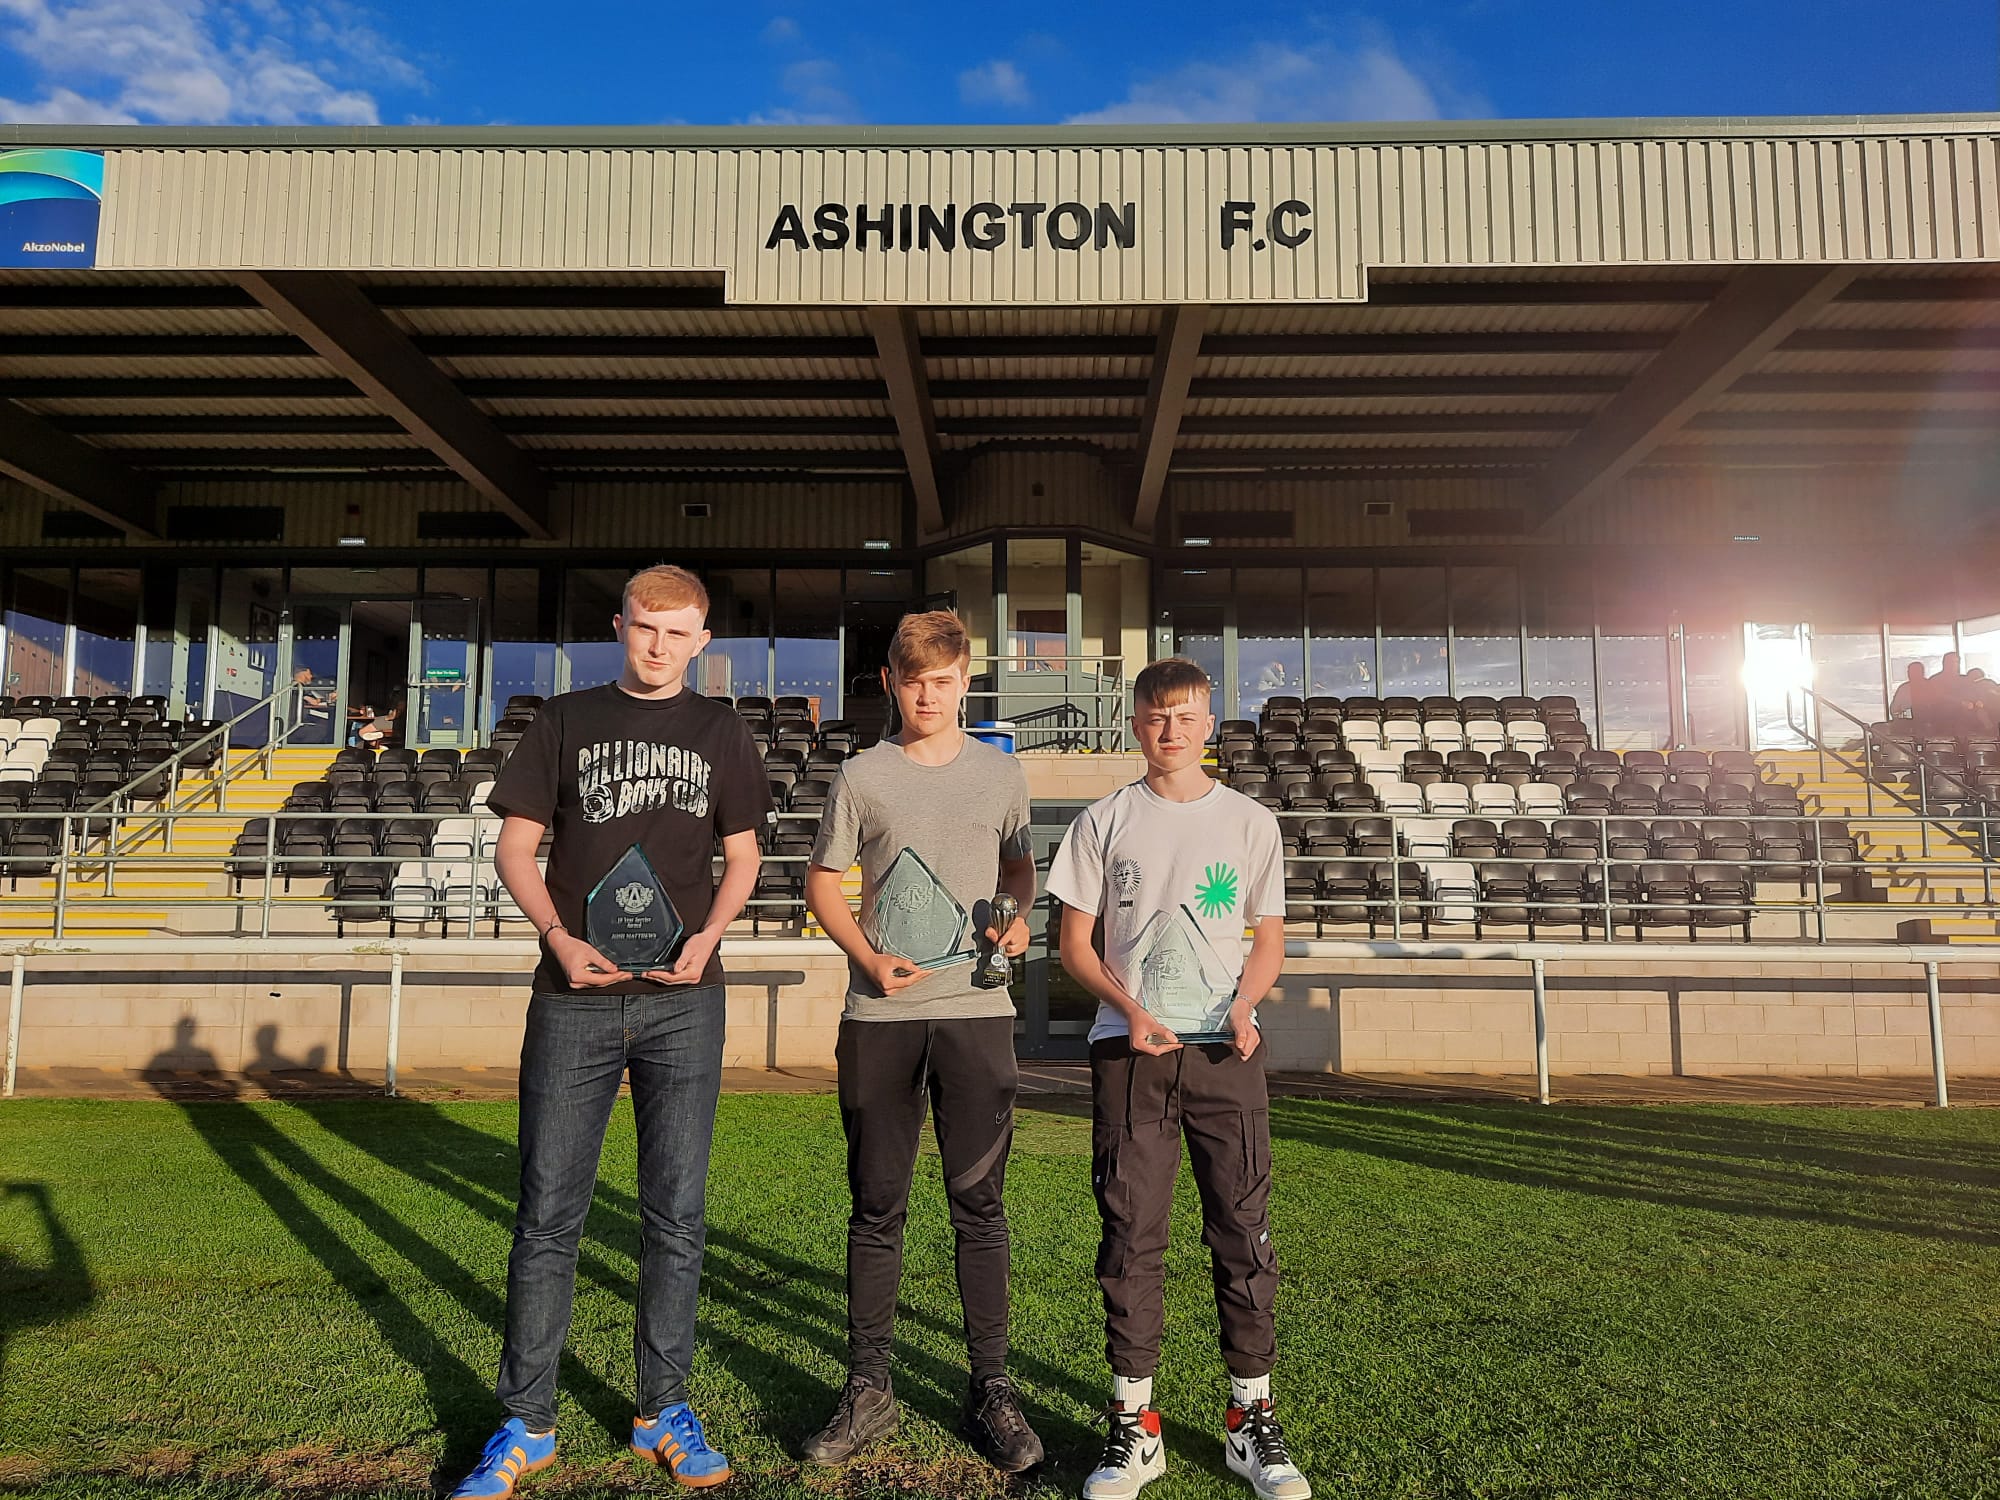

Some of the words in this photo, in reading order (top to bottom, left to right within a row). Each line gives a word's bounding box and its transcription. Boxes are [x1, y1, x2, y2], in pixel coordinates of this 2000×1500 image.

[22, 242, 85, 253] AkzoNobel
[765, 201, 1136, 252] ASHINGTON
[578, 740, 711, 798] BILLIONAIRE
[615, 778, 669, 818] BOYS
[672, 780, 709, 818] CLUB
